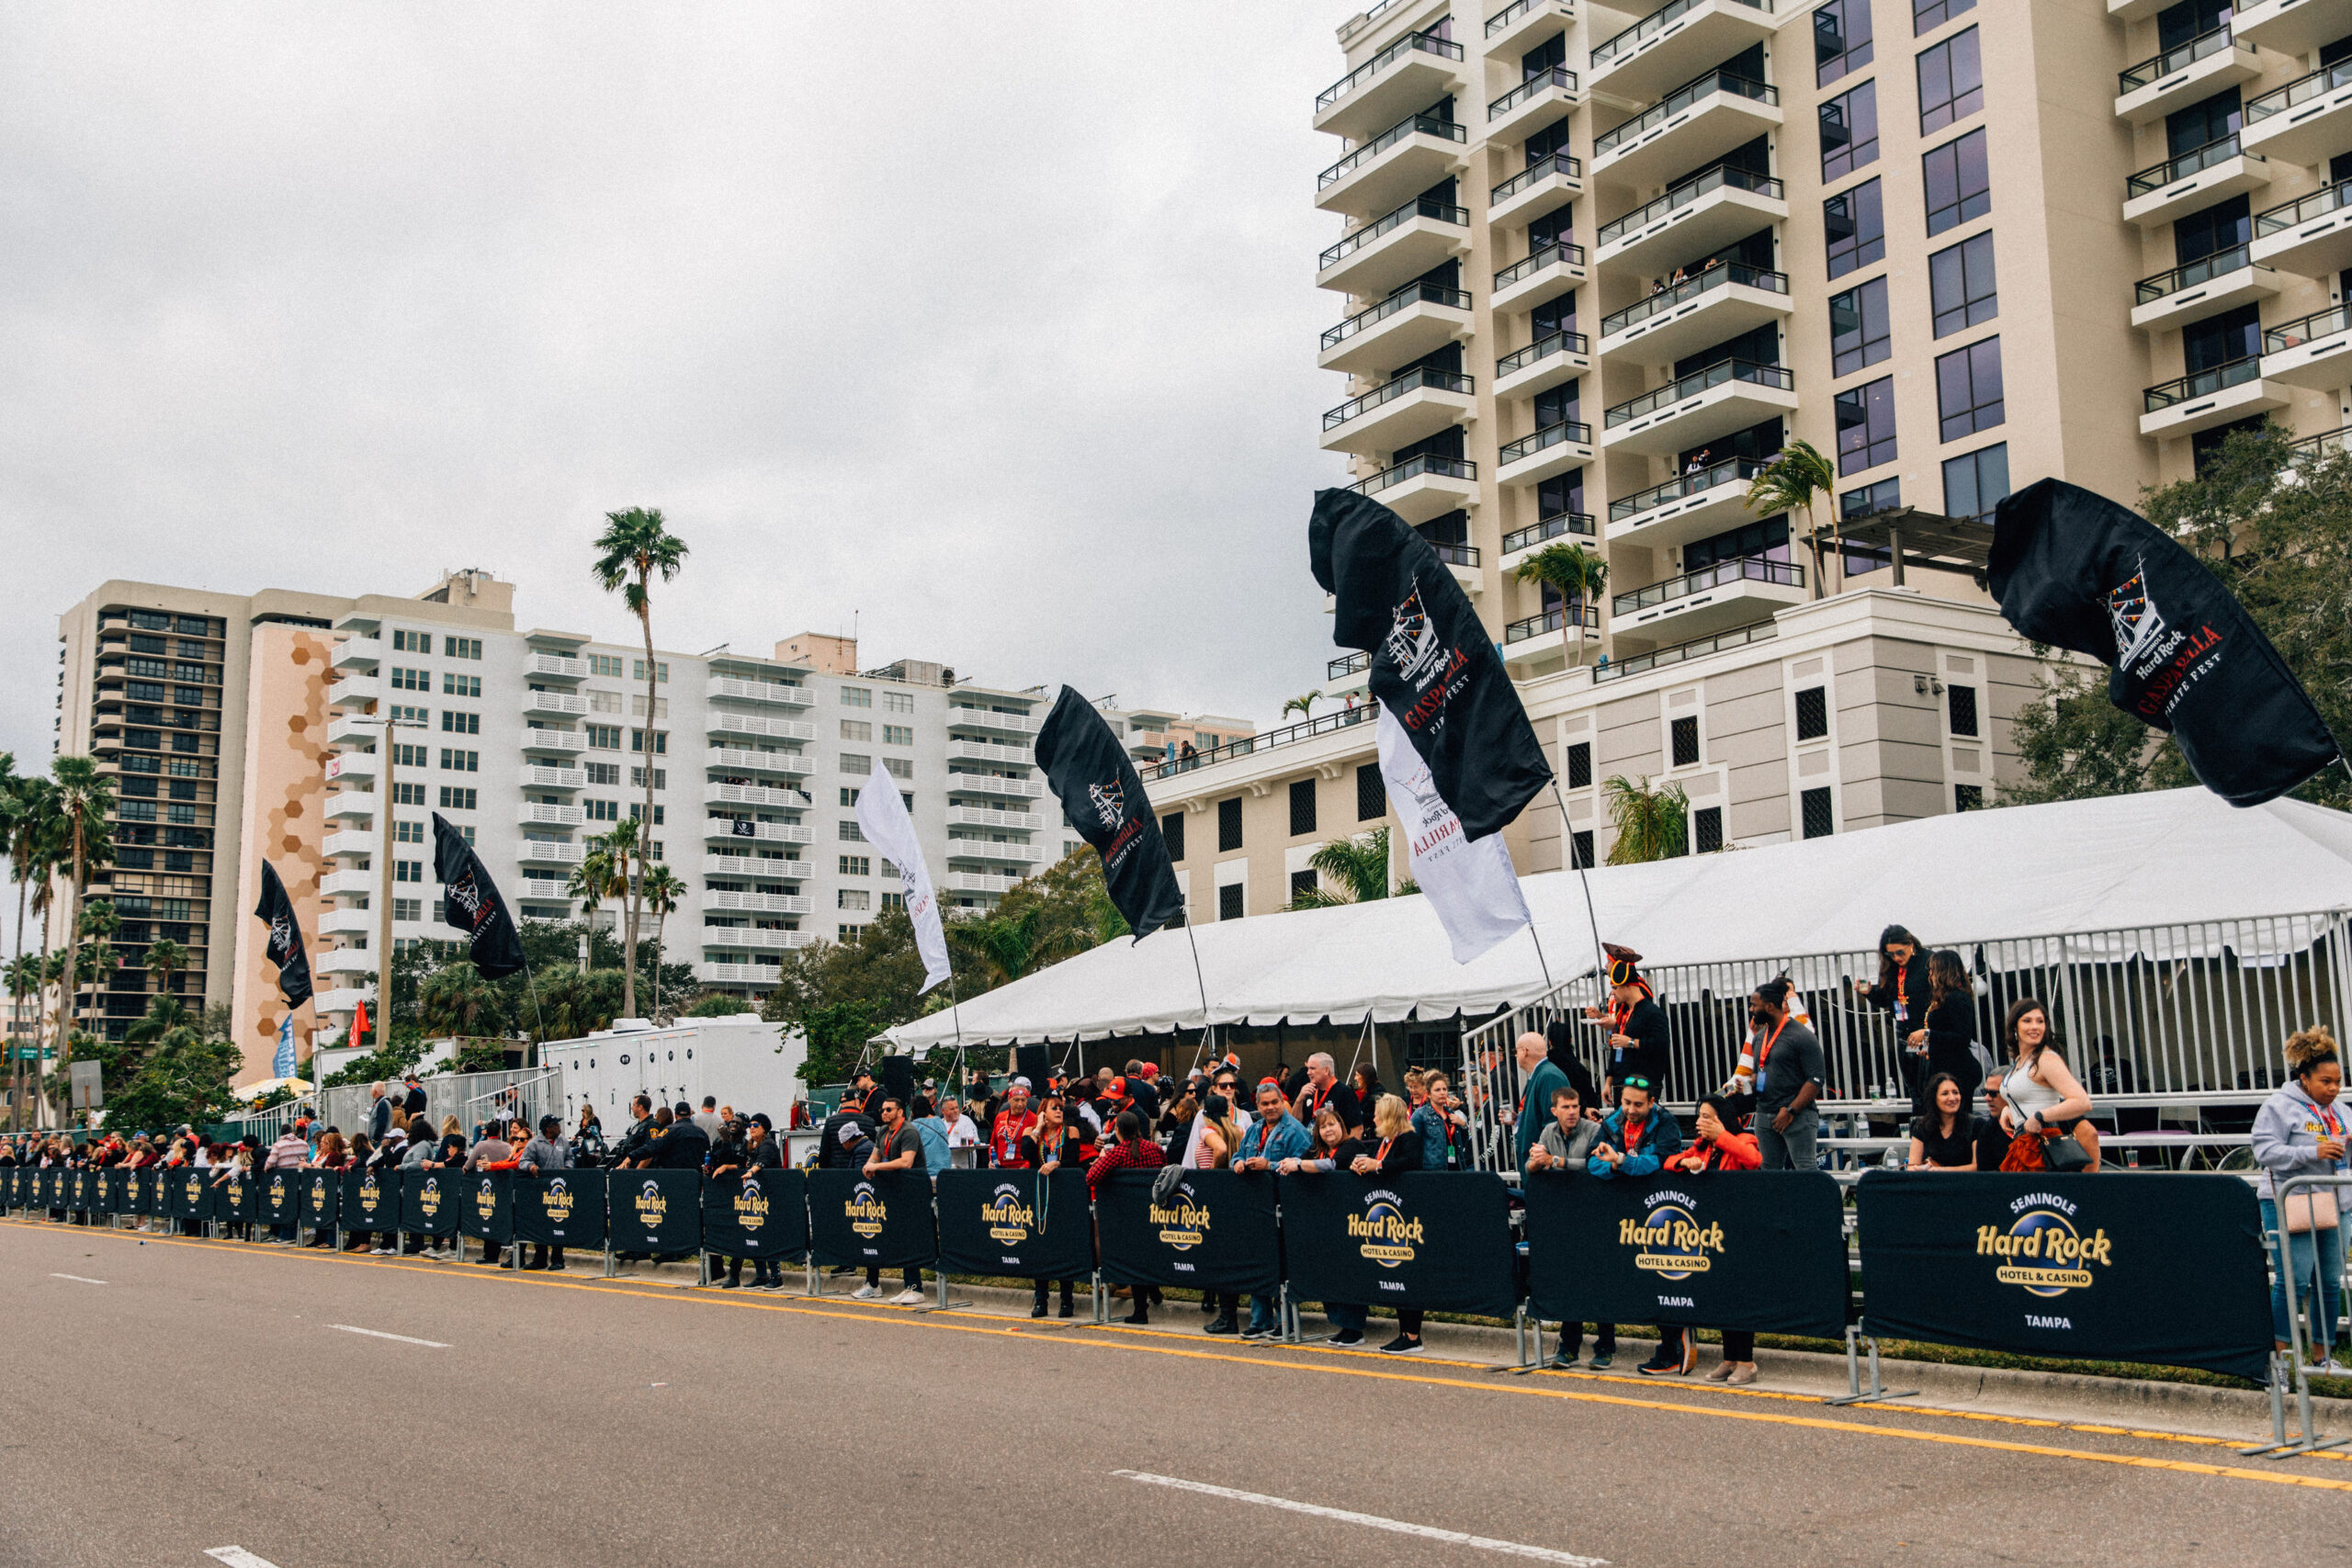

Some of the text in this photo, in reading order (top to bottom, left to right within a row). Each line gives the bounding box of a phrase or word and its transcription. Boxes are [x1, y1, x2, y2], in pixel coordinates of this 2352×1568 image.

[2136, 630, 2187, 680] Hard Rock
[2140, 634, 2165, 660] SEMINOLE
[2190, 653, 2221, 682] FEST
[1416, 666, 1435, 693] Hard
[1446, 674, 1469, 700] FEST
[1364, 1190, 1403, 1207] SEMINOLE
[1644, 1190, 1697, 1211] SEMINOLE
[2009, 1192, 2077, 1216] SEMINOLE
[845, 1201, 888, 1221] Hard Rock
[982, 1202, 1034, 1226] Hard Rock
[1149, 1202, 1211, 1230] Hard Rock
[1347, 1213, 1425, 1245] Hard Rock
[1619, 1218, 1725, 1254] Hard Rock
[1363, 1247, 1382, 1256] HOTEL
[1388, 1249, 1413, 1258] CASINO
[1976, 1224, 2112, 1267] Hard Rock
[1001, 1256, 1020, 1264] TAMPA
[1173, 1262, 1195, 1272] TAMPA
[1638, 1258, 1665, 1266] HOTEL
[1674, 1259, 1707, 1268] CASINO
[1378, 1280, 1406, 1292] TAMPA
[2000, 1269, 2033, 1280] HOTEL
[2046, 1272, 2088, 1283] CASINO
[1657, 1295, 1695, 1307] TAMPA
[2024, 1314, 2072, 1329] TAMPA
